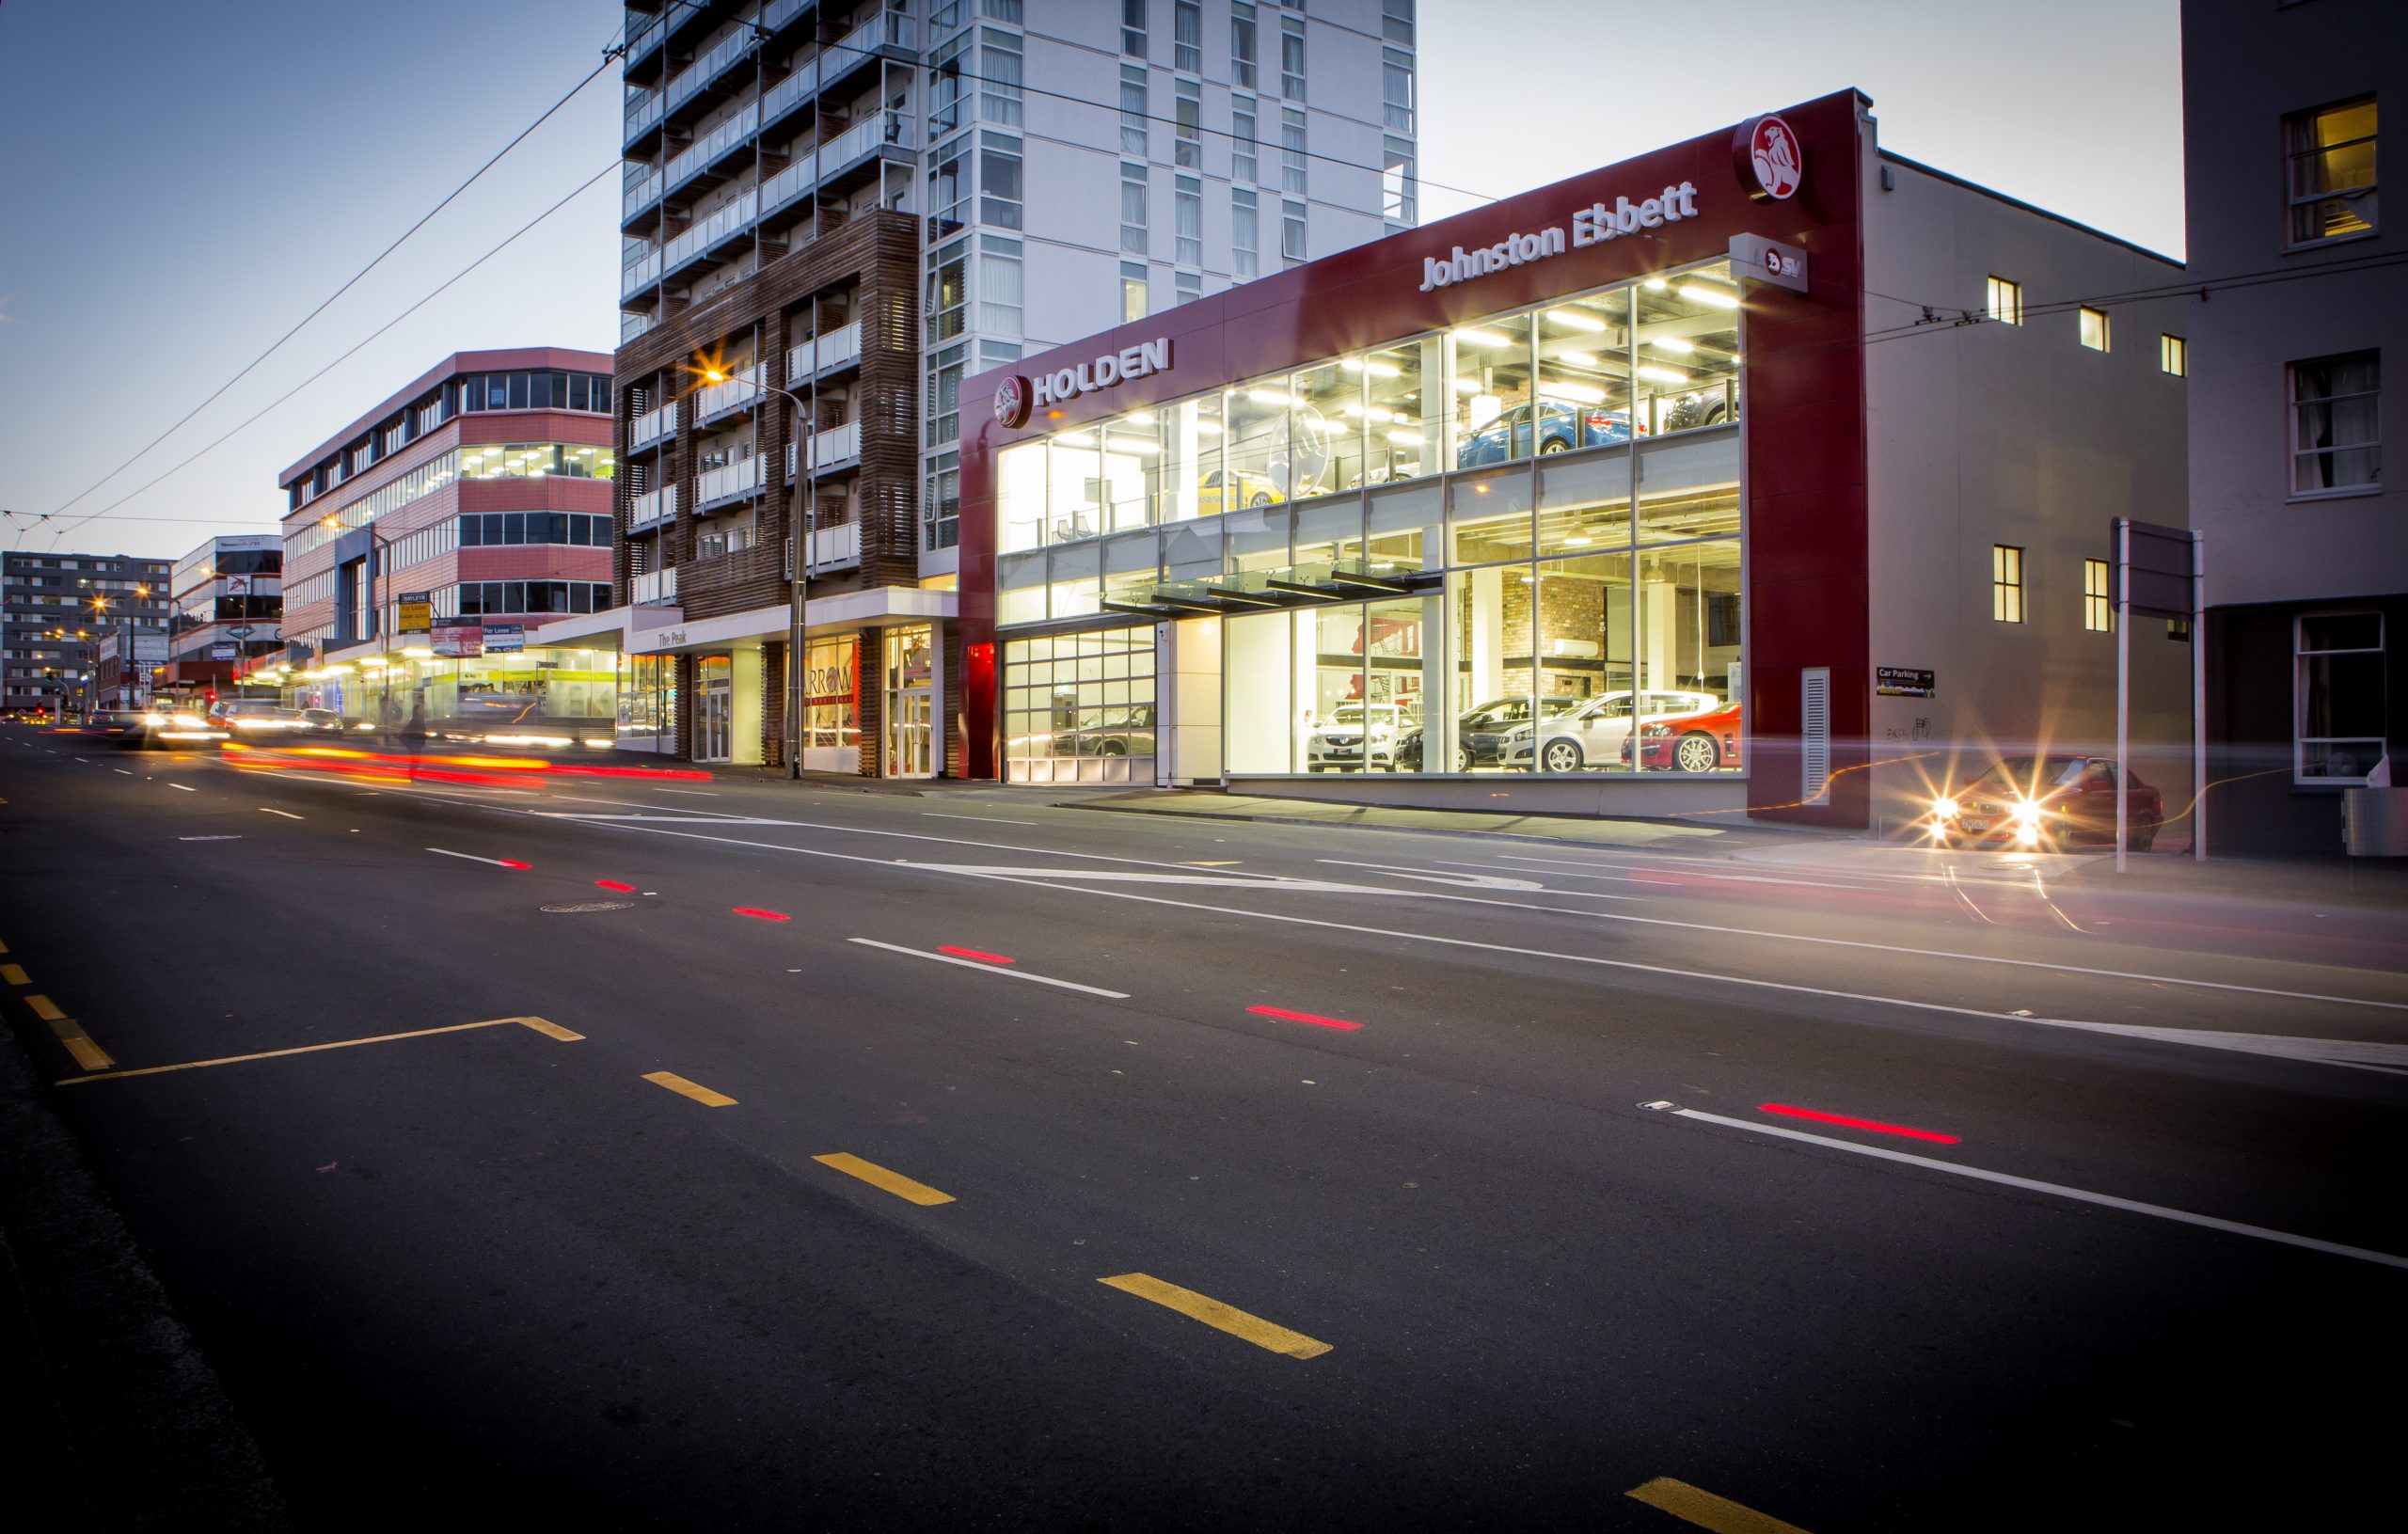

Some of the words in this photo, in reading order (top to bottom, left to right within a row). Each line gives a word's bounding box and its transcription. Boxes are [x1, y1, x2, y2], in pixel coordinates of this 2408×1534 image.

[1419, 226, 1565, 293] Johnston
[1573, 182, 1699, 248] Ebbett
[1034, 337, 1170, 407] HOLDEN
[657, 632, 671, 648] The
[671, 629, 687, 645] Peak
[804, 666, 854, 695] RROW
[1878, 669, 1892, 677] Car
[1893, 670, 1919, 680] Parking
